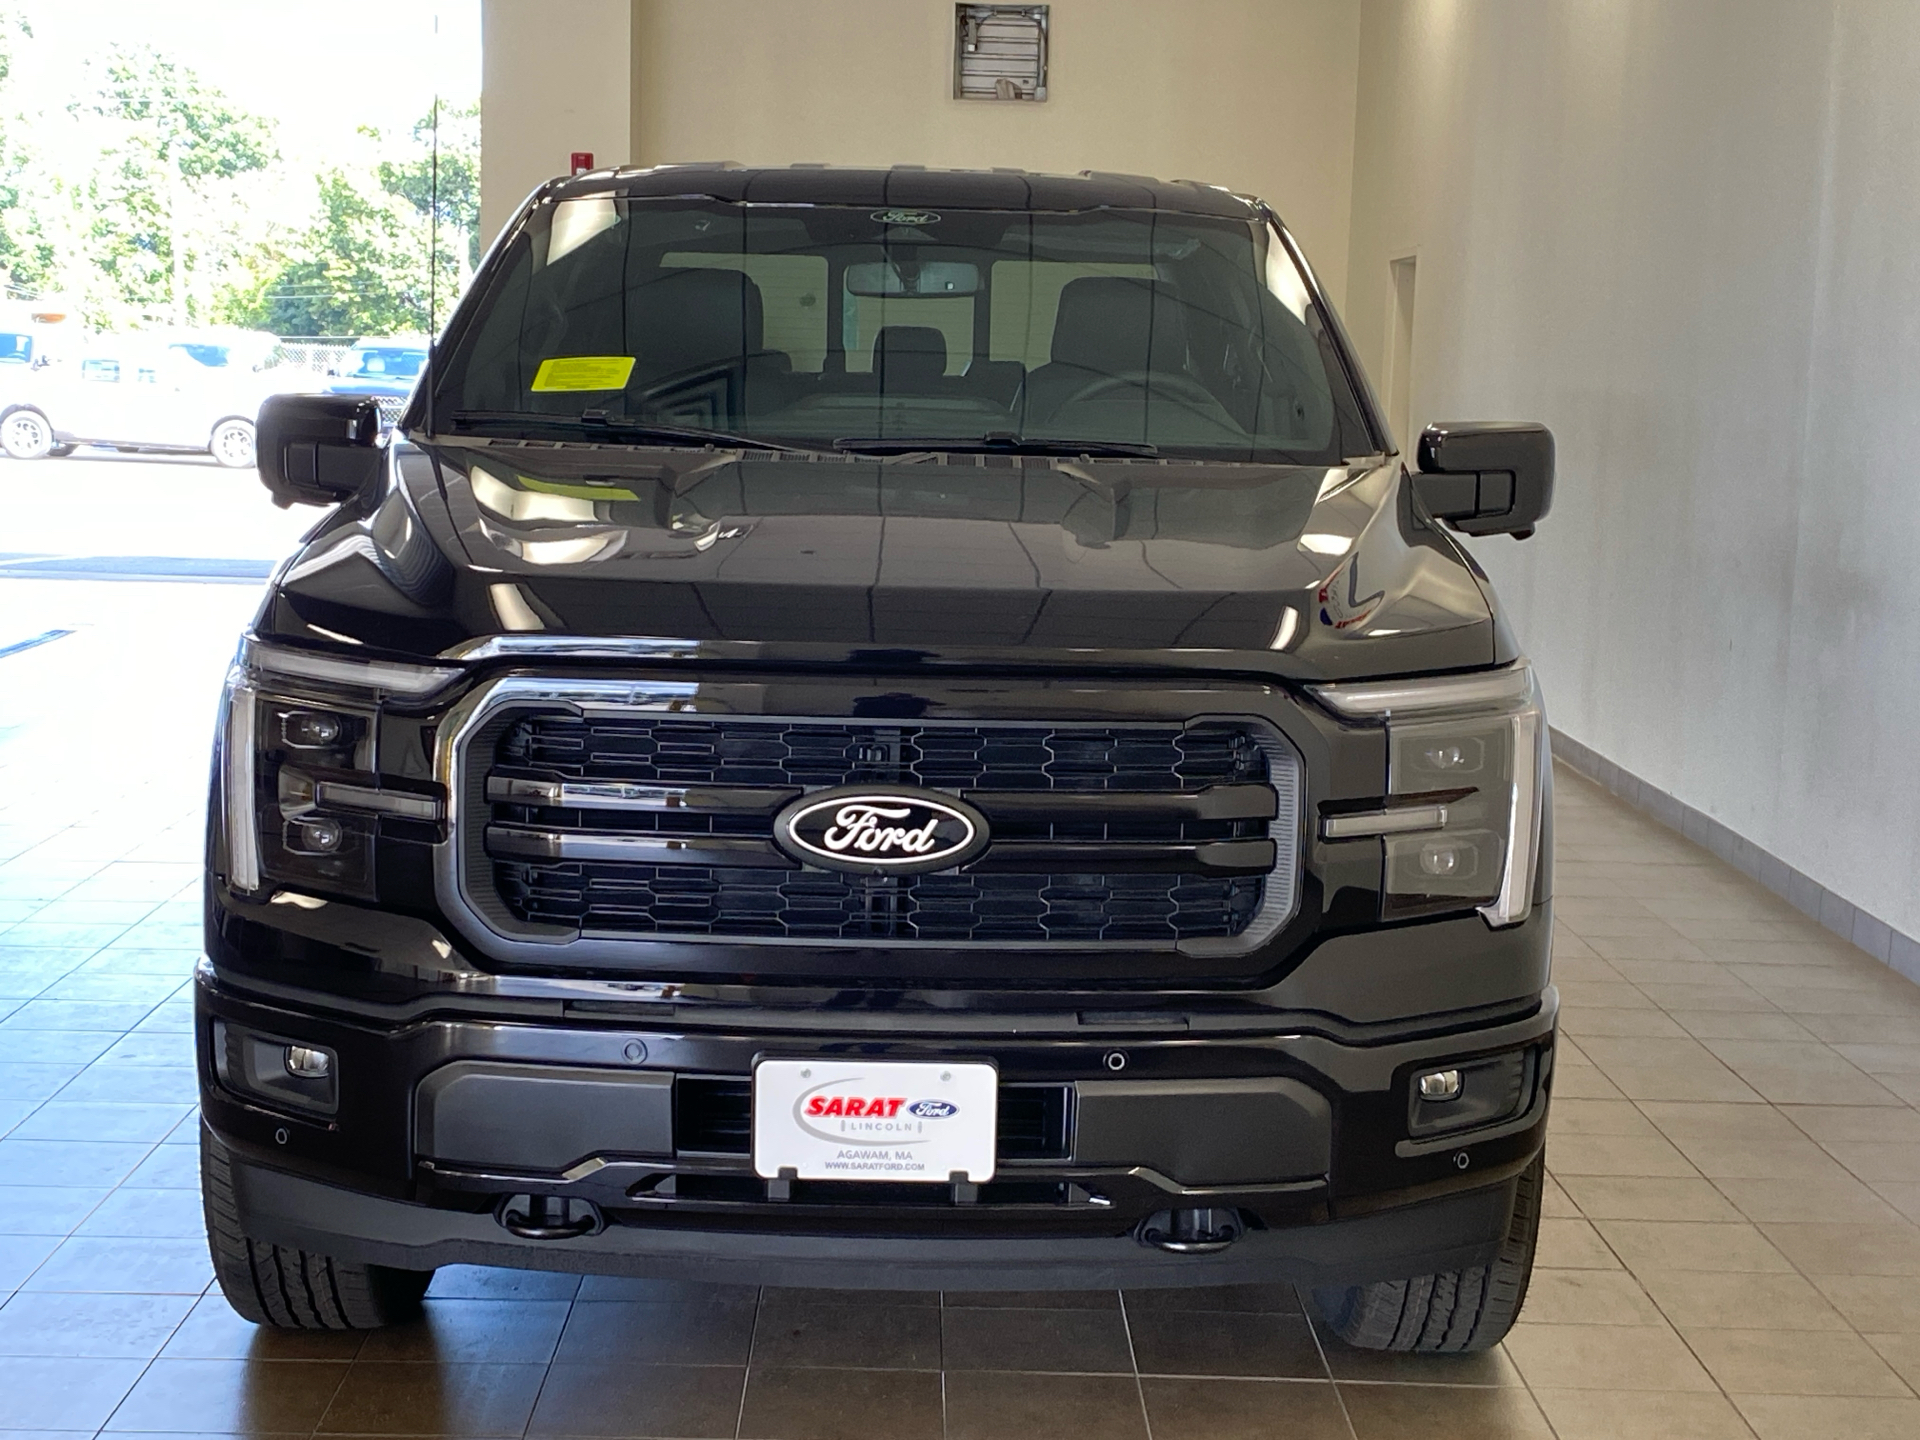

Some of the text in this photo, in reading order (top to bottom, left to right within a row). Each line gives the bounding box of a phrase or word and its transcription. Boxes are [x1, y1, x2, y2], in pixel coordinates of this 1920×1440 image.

[882, 208, 929, 224] Ford
[823, 804, 939, 853] Ford
[804, 1095, 950, 1119] SARAT Ford
[850, 1121, 912, 1132] LINCOLN
[836, 1149, 913, 1162] AGAWAM, MA
[824, 1161, 926, 1172] WWW.SARATFORD.COM
